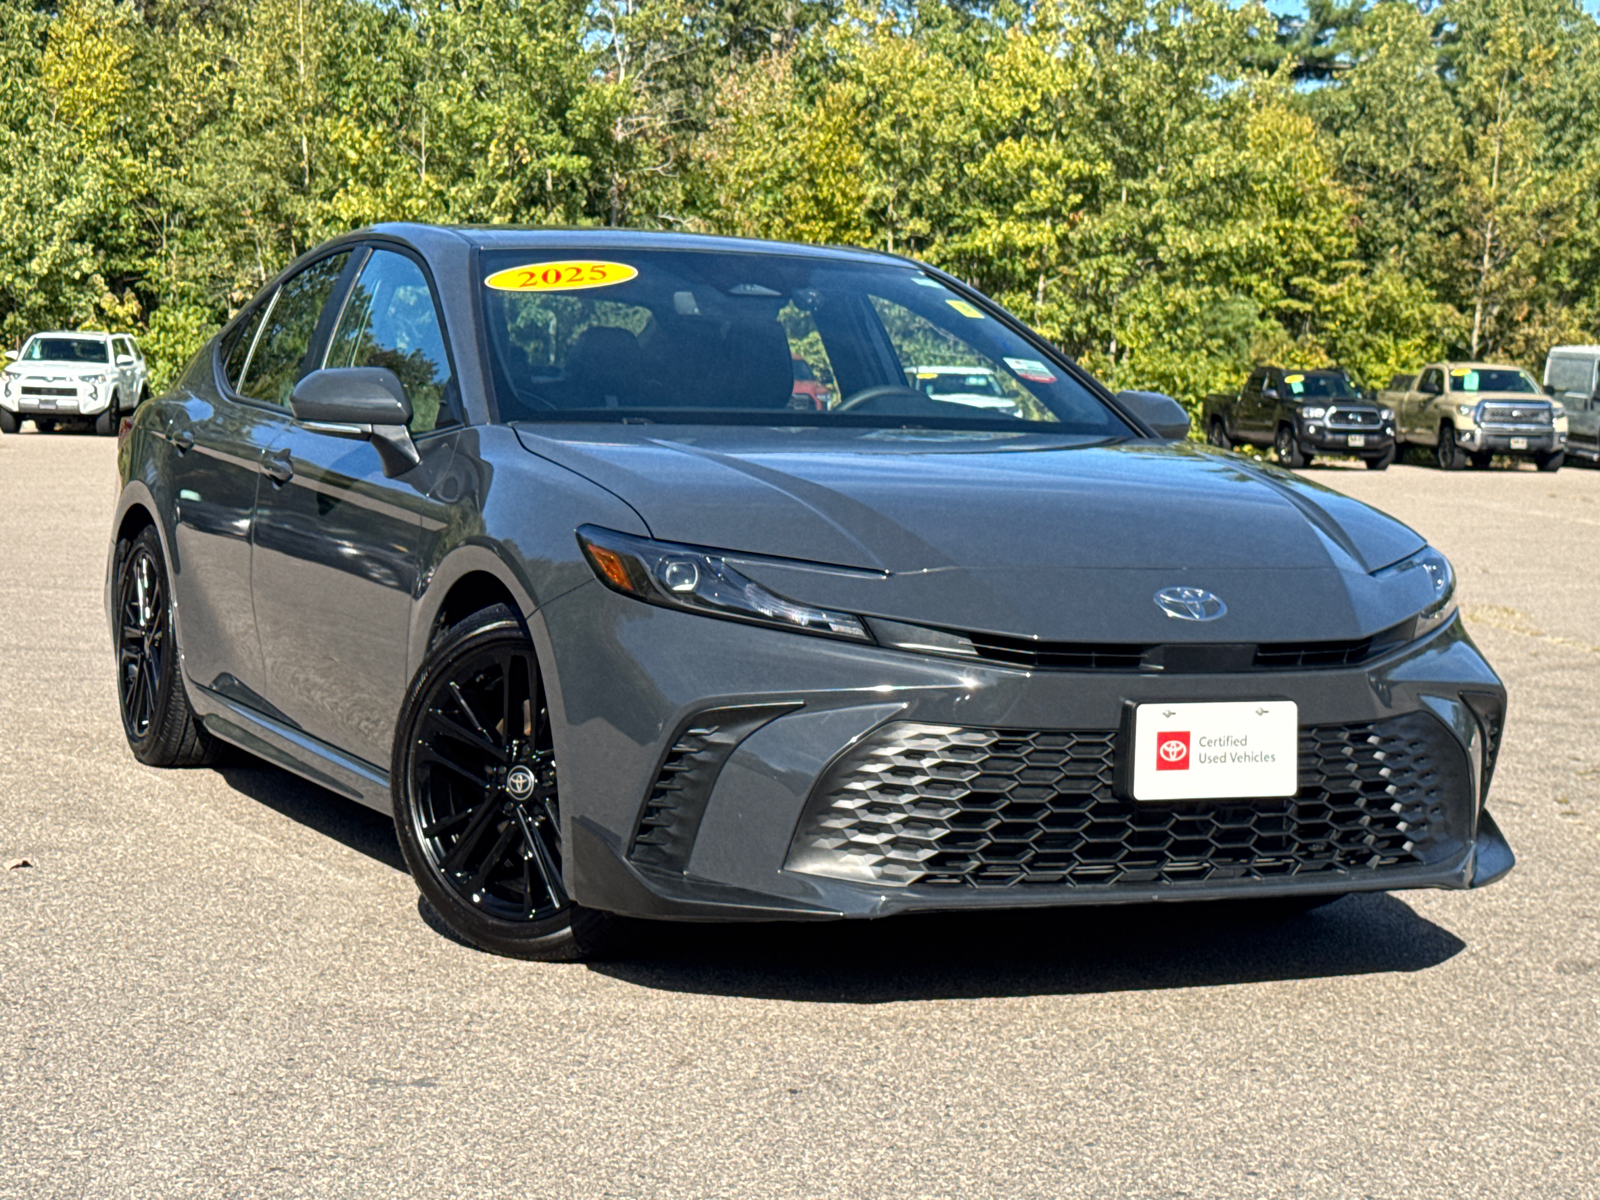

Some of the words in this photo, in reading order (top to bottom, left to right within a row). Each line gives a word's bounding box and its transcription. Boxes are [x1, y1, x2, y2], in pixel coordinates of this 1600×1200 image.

[518, 265, 607, 288] 2025
[1199, 735, 1247, 747] Certified
[1199, 752, 1227, 763] Used
[1230, 751, 1276, 763] Vehicles
